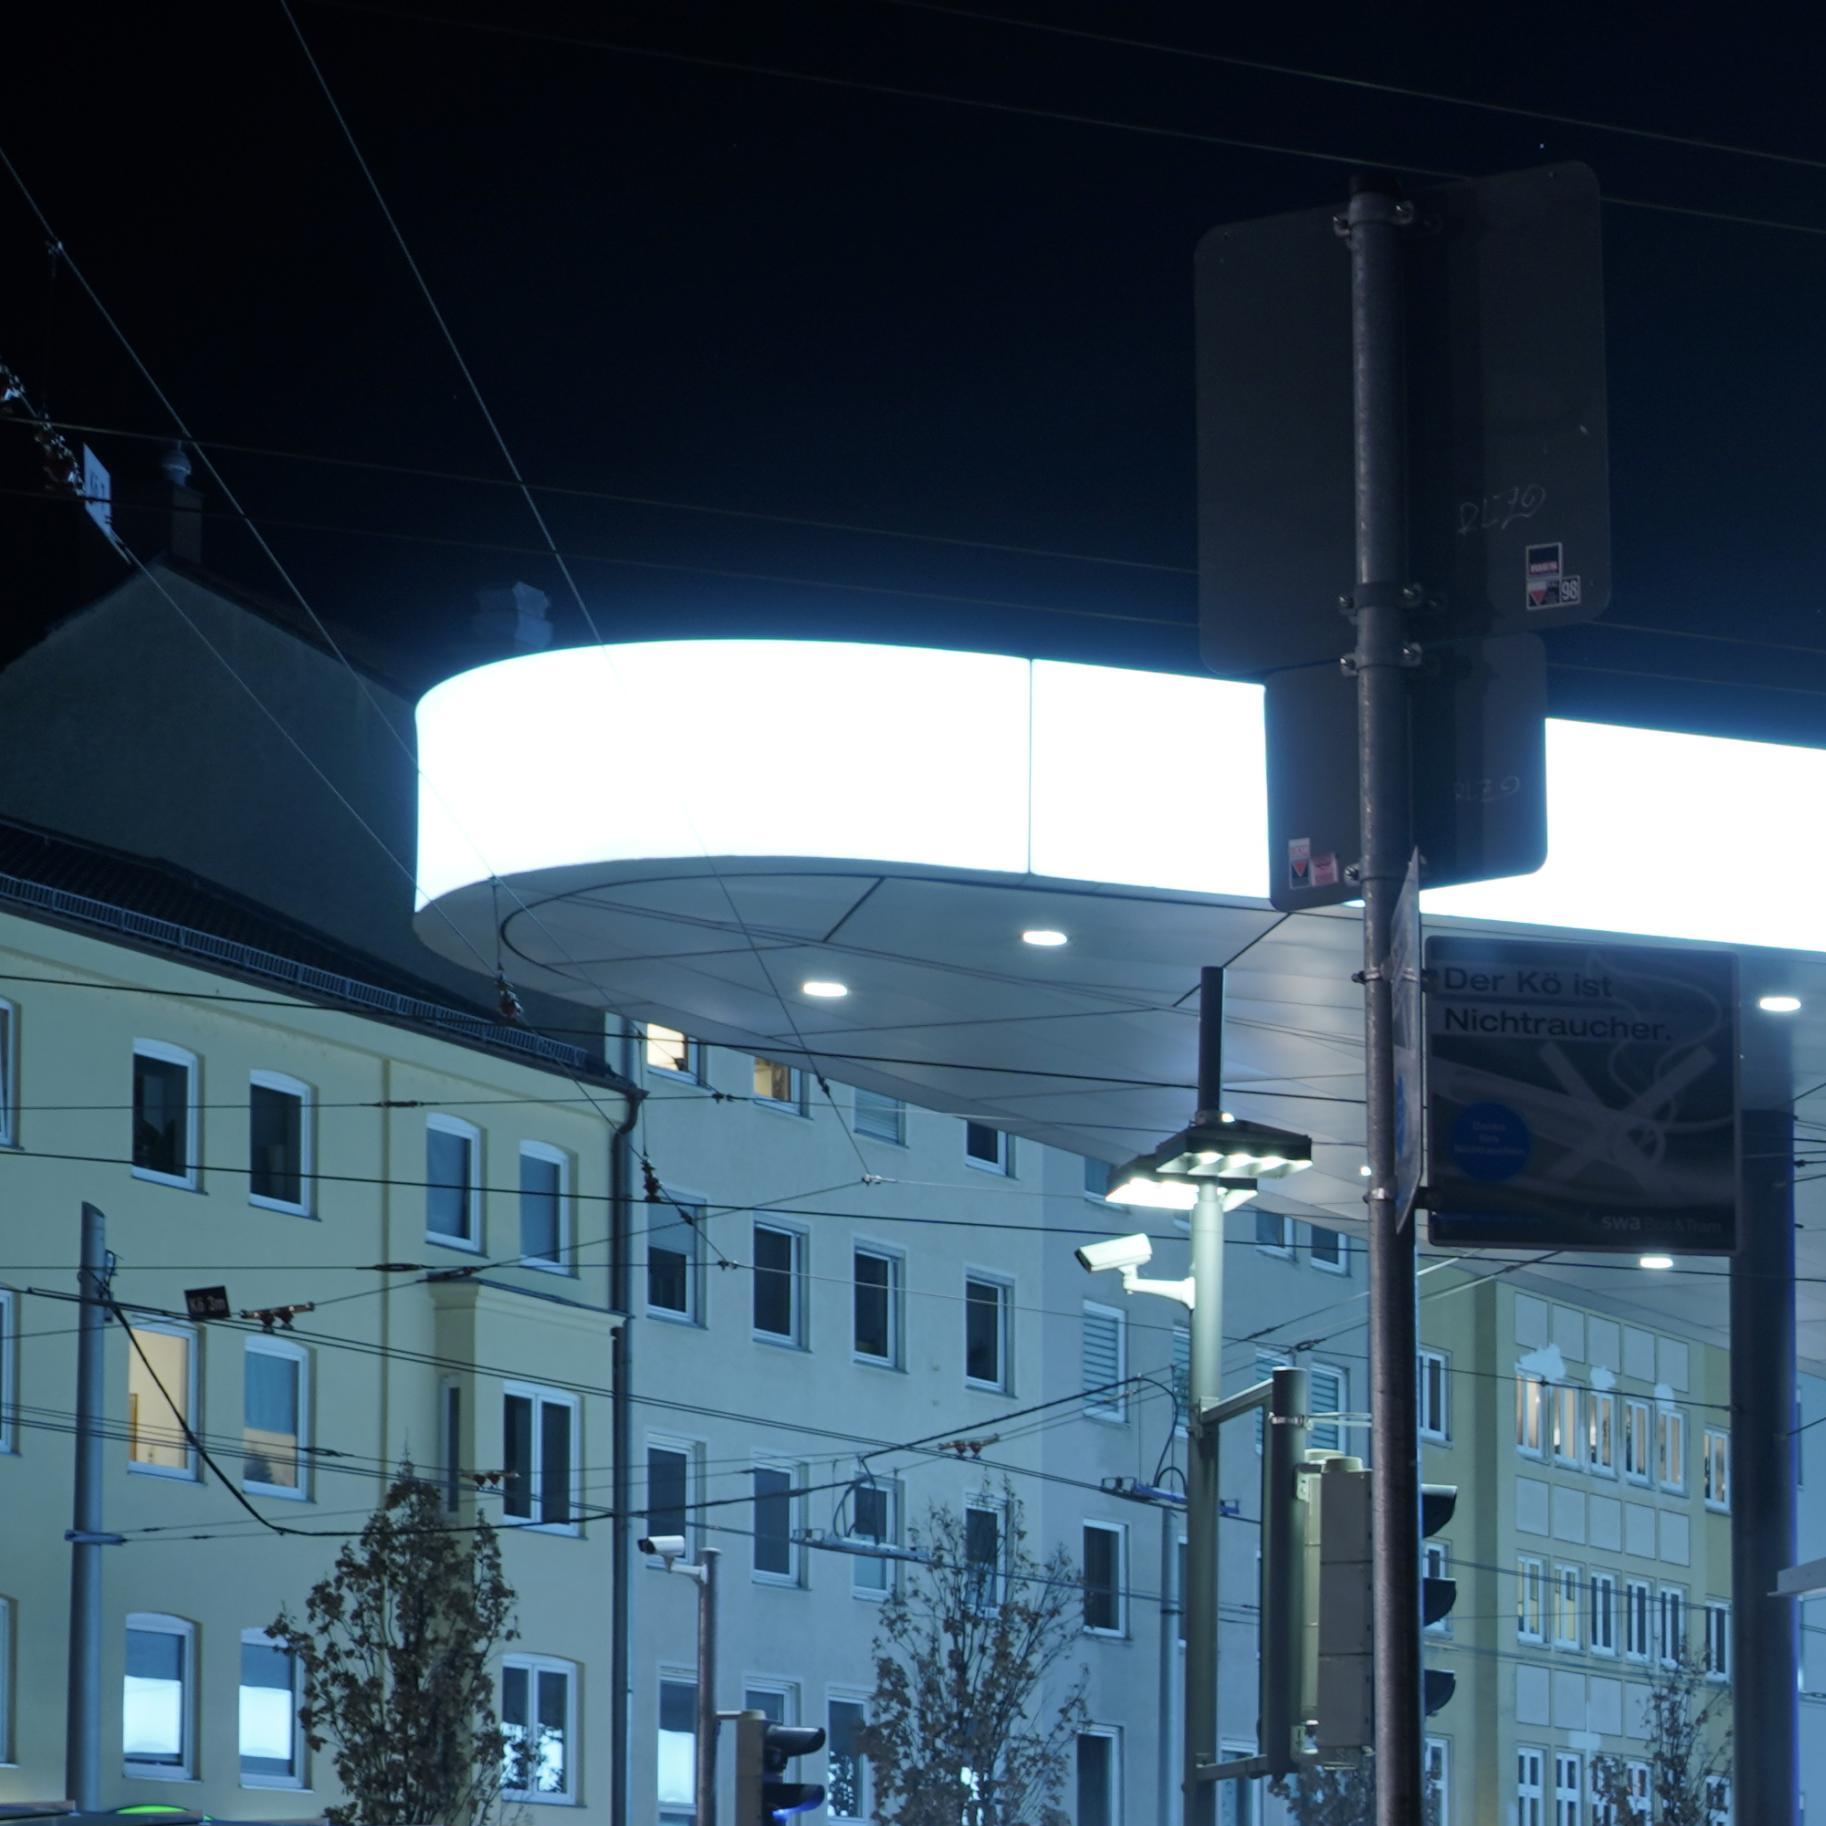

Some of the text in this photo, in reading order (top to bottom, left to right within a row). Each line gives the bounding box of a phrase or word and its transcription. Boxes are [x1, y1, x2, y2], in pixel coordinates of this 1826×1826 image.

[1561, 578, 1579, 600] 98
[1445, 968, 1613, 997] Der Kö ist
[1445, 1008, 1672, 1041] Nichtraucher.
[1601, 1215, 1640, 1231] swa
